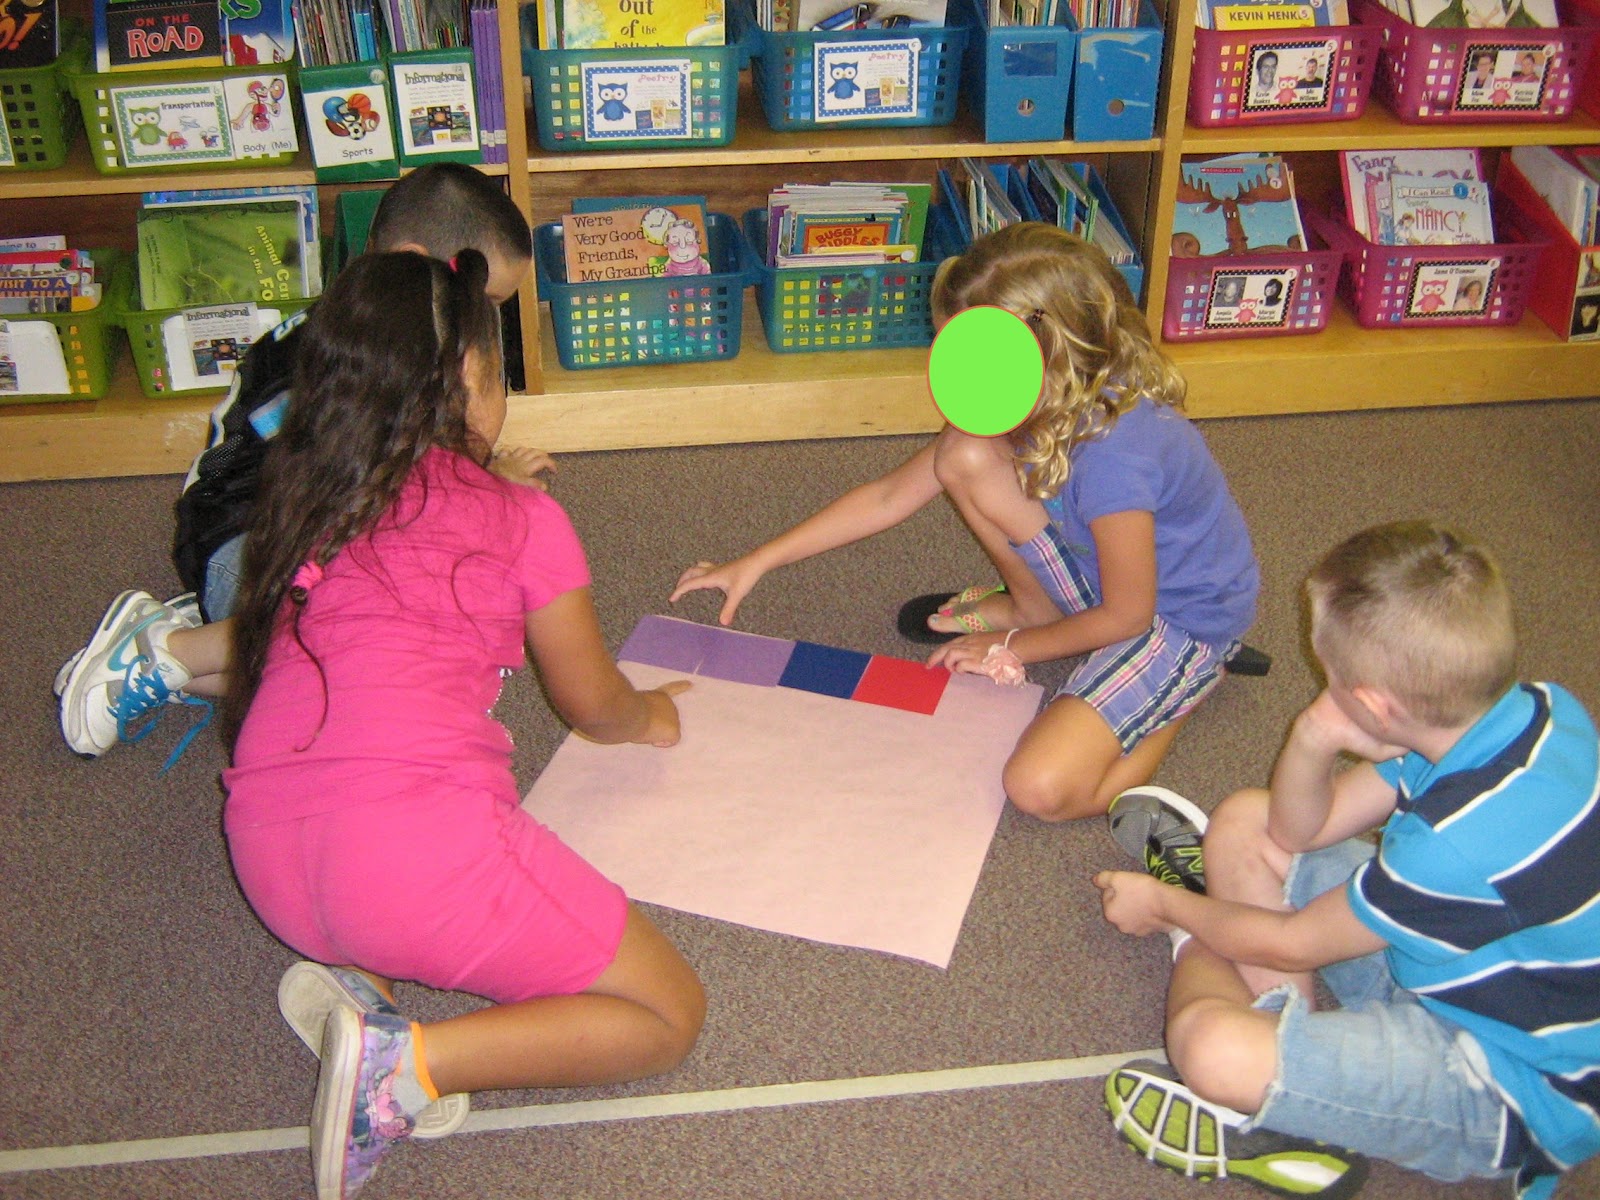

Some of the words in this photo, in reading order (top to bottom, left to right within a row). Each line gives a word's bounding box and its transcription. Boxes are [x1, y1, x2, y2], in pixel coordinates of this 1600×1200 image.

[134, 16, 156, 27] ON
[161, 13, 191, 25] THE
[1229, 11, 1264, 22] KEVIN
[1268, 10, 1310, 21] HENK
[620, 19, 639, 38] of
[642, 25, 657, 34] the
[126, 26, 204, 58] ROAD
[868, 53, 906, 62] Poetry
[638, 74, 677, 84] Poetry
[160, 100, 216, 111] Transportation
[243, 144, 266, 153] Body
[271, 140, 292, 150] (Me)
[342, 147, 374, 159] Sports
[1351, 154, 1396, 172] Fancy
[573, 215, 614, 228] We're
[1415, 208, 1465, 232] NANCY
[574, 232, 608, 246] Very
[609, 228, 645, 242] Good
[816, 227, 863, 244] BUGGY
[818, 236, 881, 248] IDDLES
[256, 225, 282, 266] Animal
[248, 246, 256, 257] in
[252, 258, 263, 275] the
[578, 247, 638, 264] Friends,
[579, 268, 602, 282] My
[605, 262, 667, 278] Grandpa
[32, 278, 50, 288] TO
[54, 278, 66, 288] A
